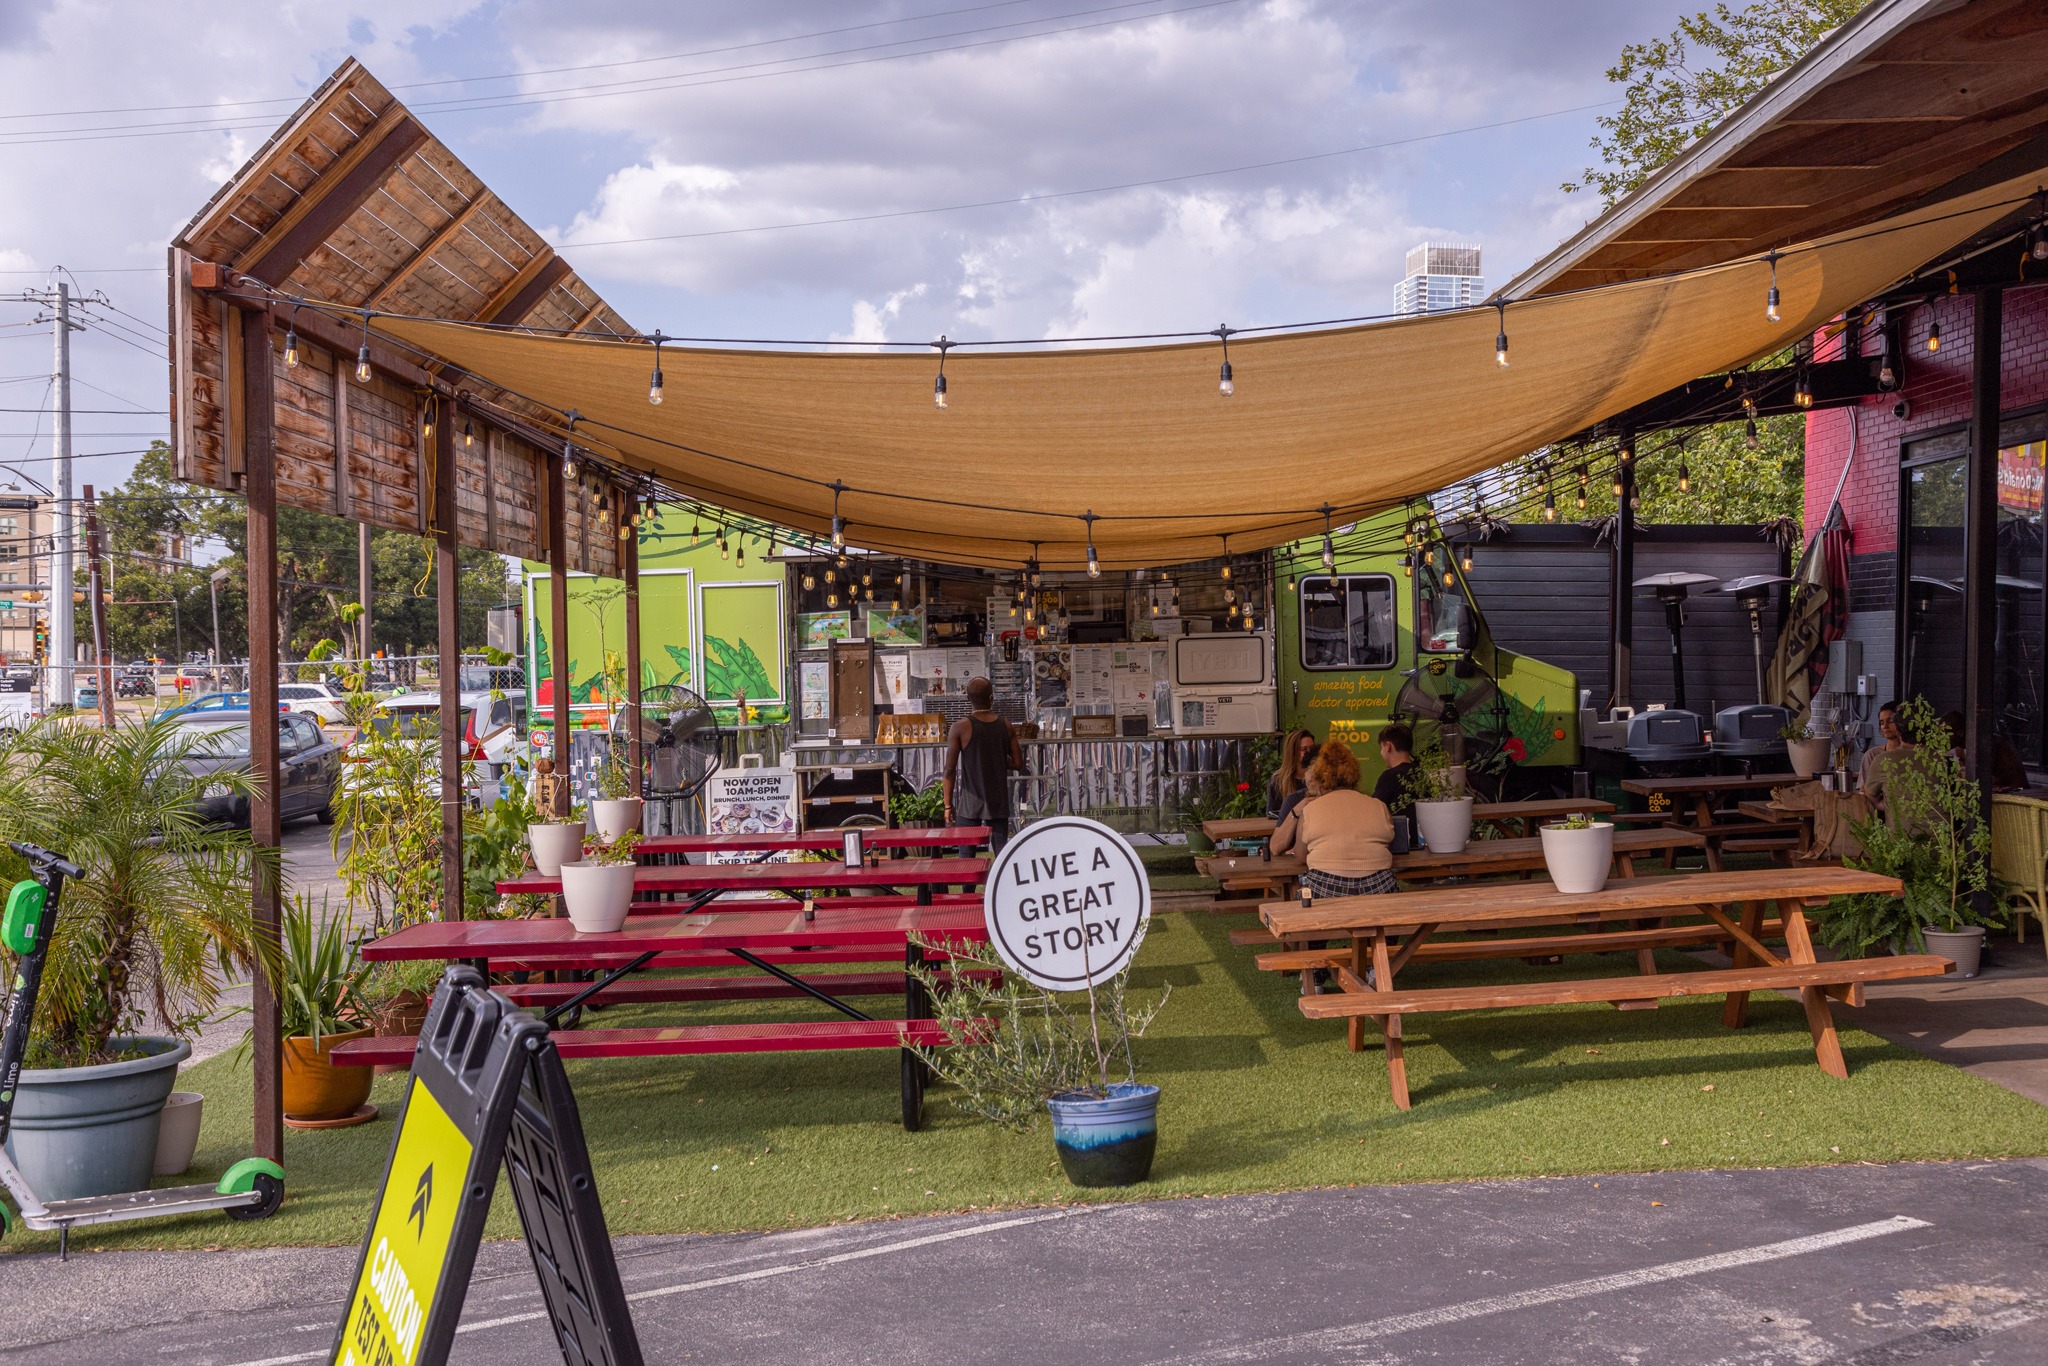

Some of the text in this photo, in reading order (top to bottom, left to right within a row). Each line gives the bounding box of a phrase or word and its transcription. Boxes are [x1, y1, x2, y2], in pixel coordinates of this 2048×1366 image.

[1314, 675, 1385, 694] amazing food
[1308, 692, 1390, 711] doctor approved
[1077, 722, 1111, 732] WELCME
[1329, 720, 1356, 731] ATX
[1328, 732, 1370, 743] FOOD
[723, 777, 781, 787] NOW OPEN
[725, 786, 779, 795] 10AM-8PM
[766, 856, 788, 864] LINE
[1013, 846, 1111, 886] LIVE A
[1019, 881, 1116, 922] GREAT
[1025, 917, 1121, 959] STORY
[3, 1061, 19, 1089] Lime
[370, 1236, 423, 1365] CAUTION
[355, 1293, 380, 1364] TEST
